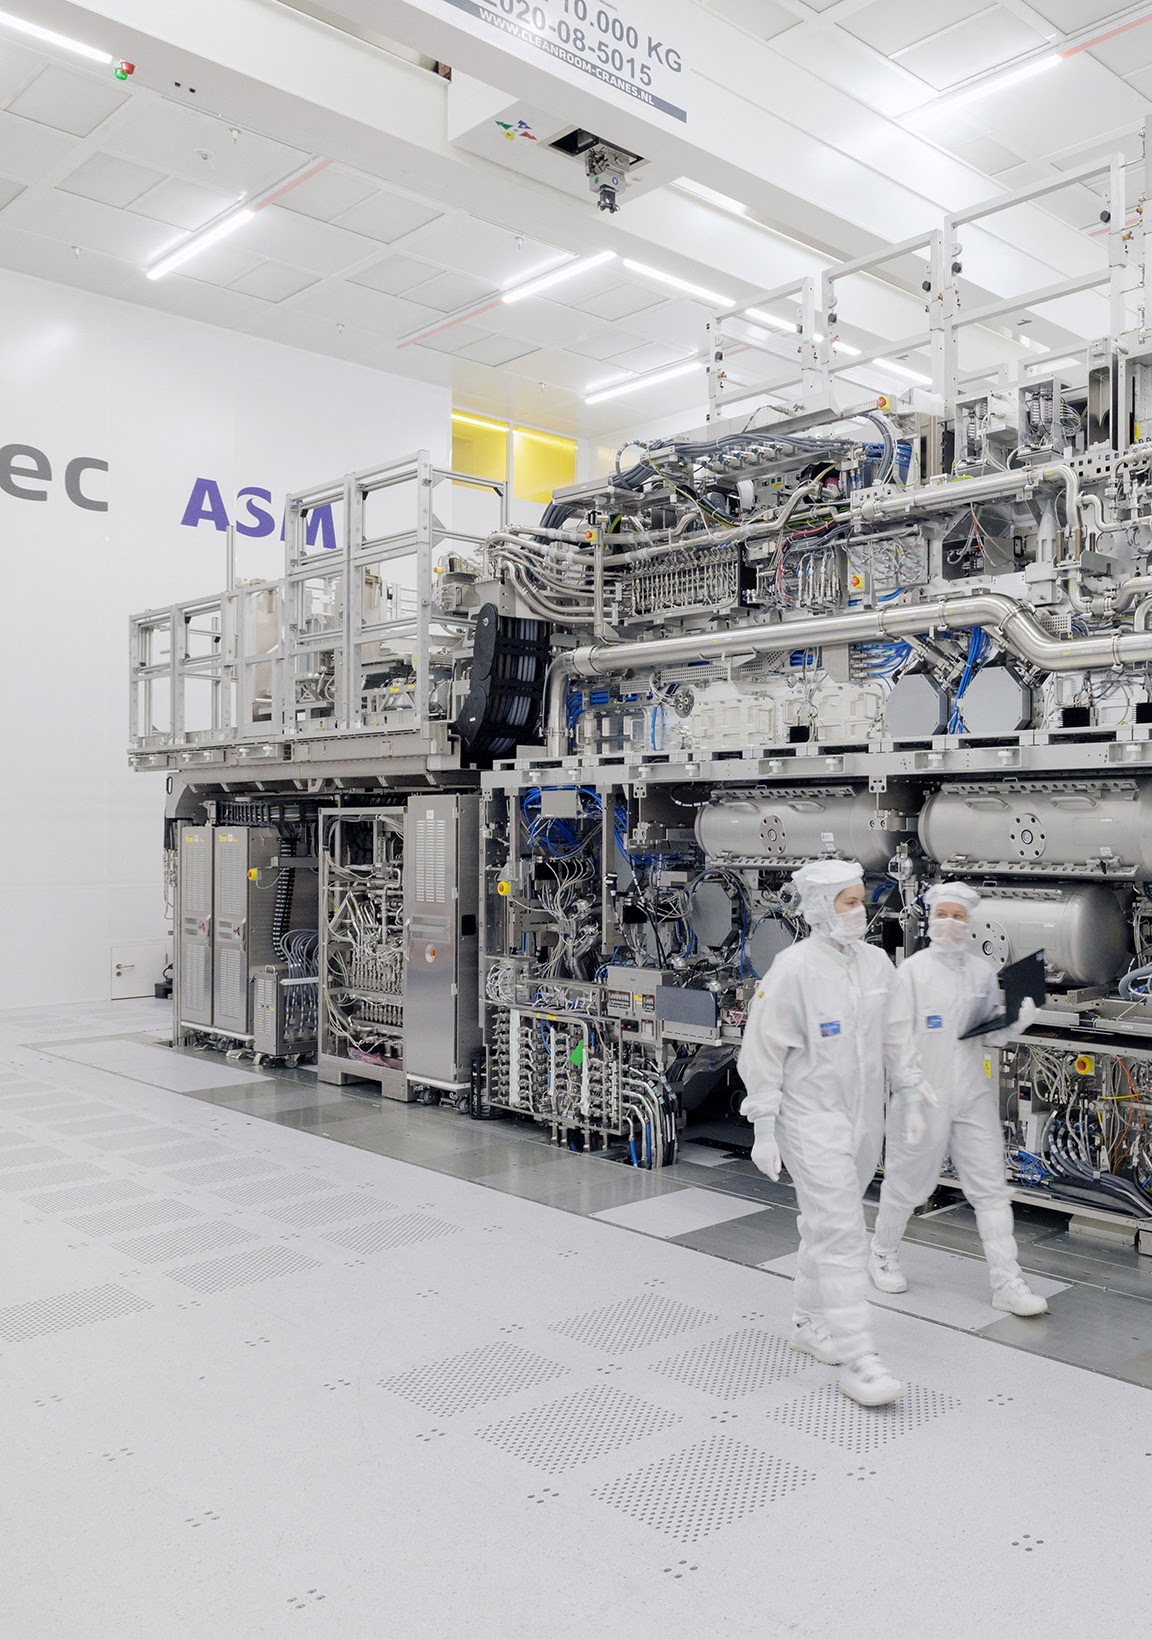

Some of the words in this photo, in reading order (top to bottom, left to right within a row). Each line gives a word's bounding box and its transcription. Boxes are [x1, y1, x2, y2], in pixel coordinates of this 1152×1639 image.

[479, 7, 655, 106] WWW.CLEANROOM-CRANES.NL
[564, 0, 639, 50] 10.000
[647, 35, 682, 73] KG
[0, 443, 109, 513] ec
[181, 477, 337, 550] ASM
